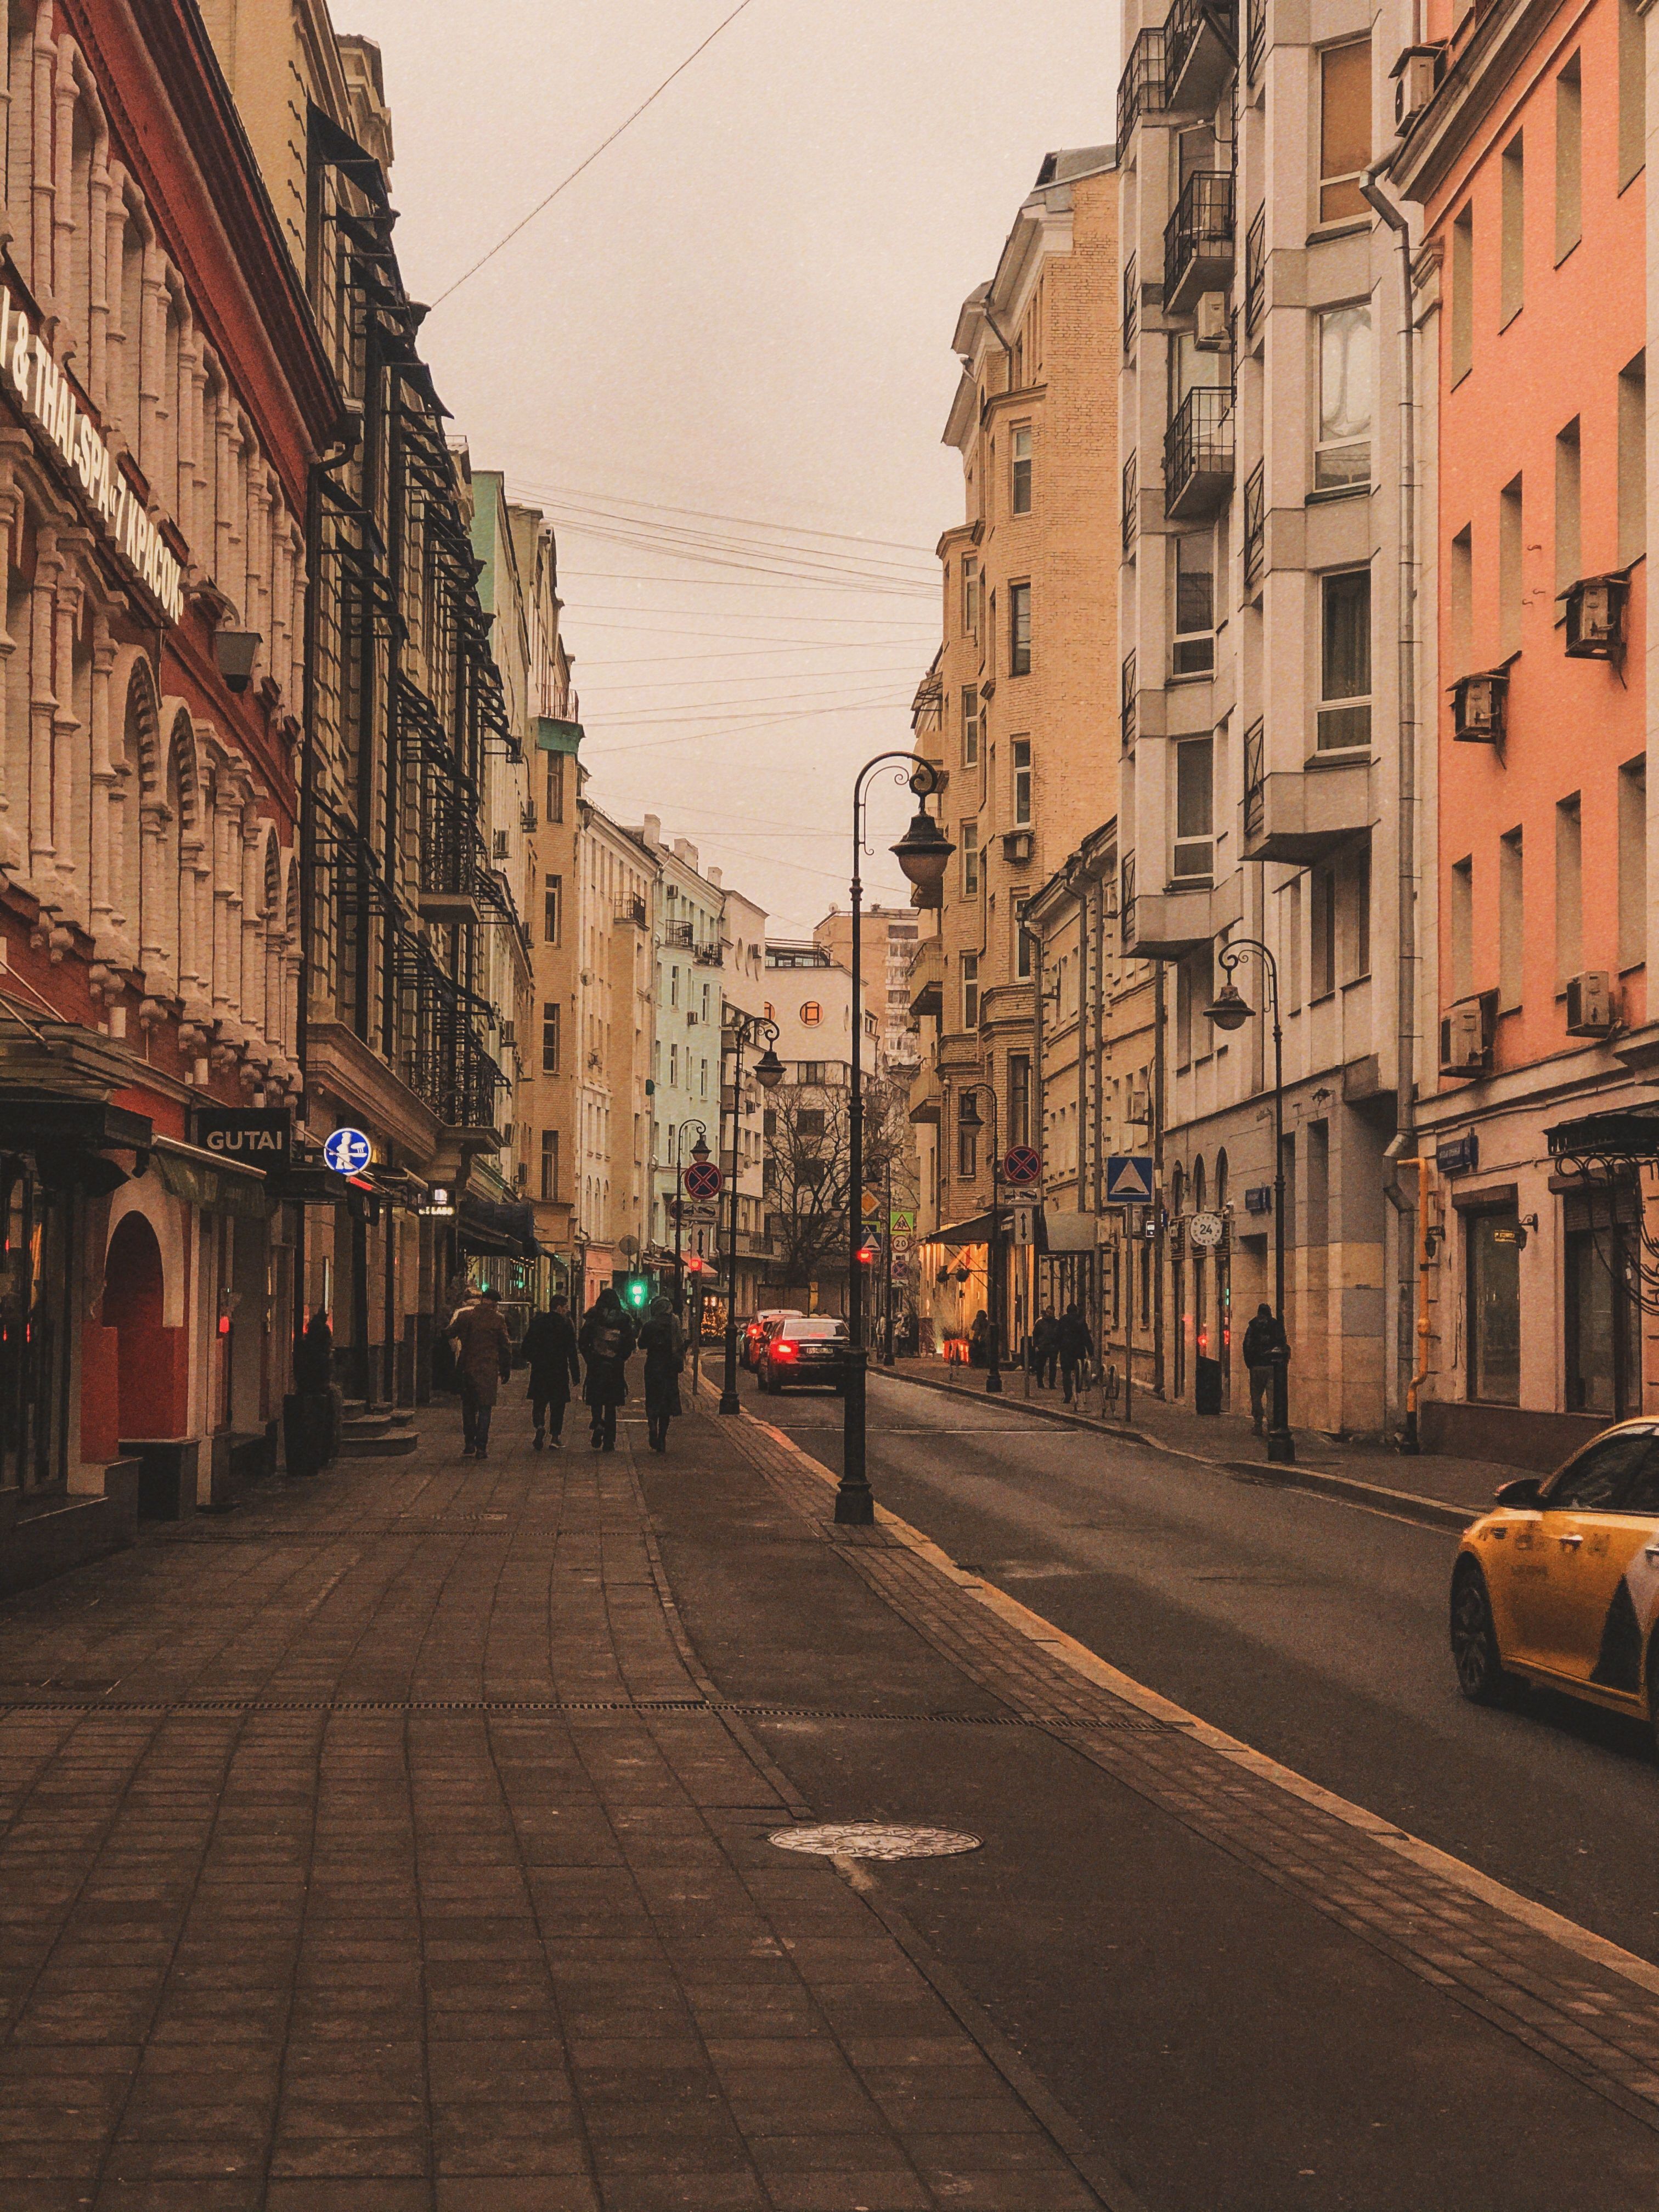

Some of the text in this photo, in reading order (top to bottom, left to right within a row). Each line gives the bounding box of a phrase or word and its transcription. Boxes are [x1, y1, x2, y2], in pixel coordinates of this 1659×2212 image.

[13, 311, 29, 402] &
[35, 335, 109, 523] THAI-SPA
[126, 491, 183, 625] КРАСОК»
[207, 1131, 282, 1150] GUTAI
[1200, 1224, 1212, 1234] 24
